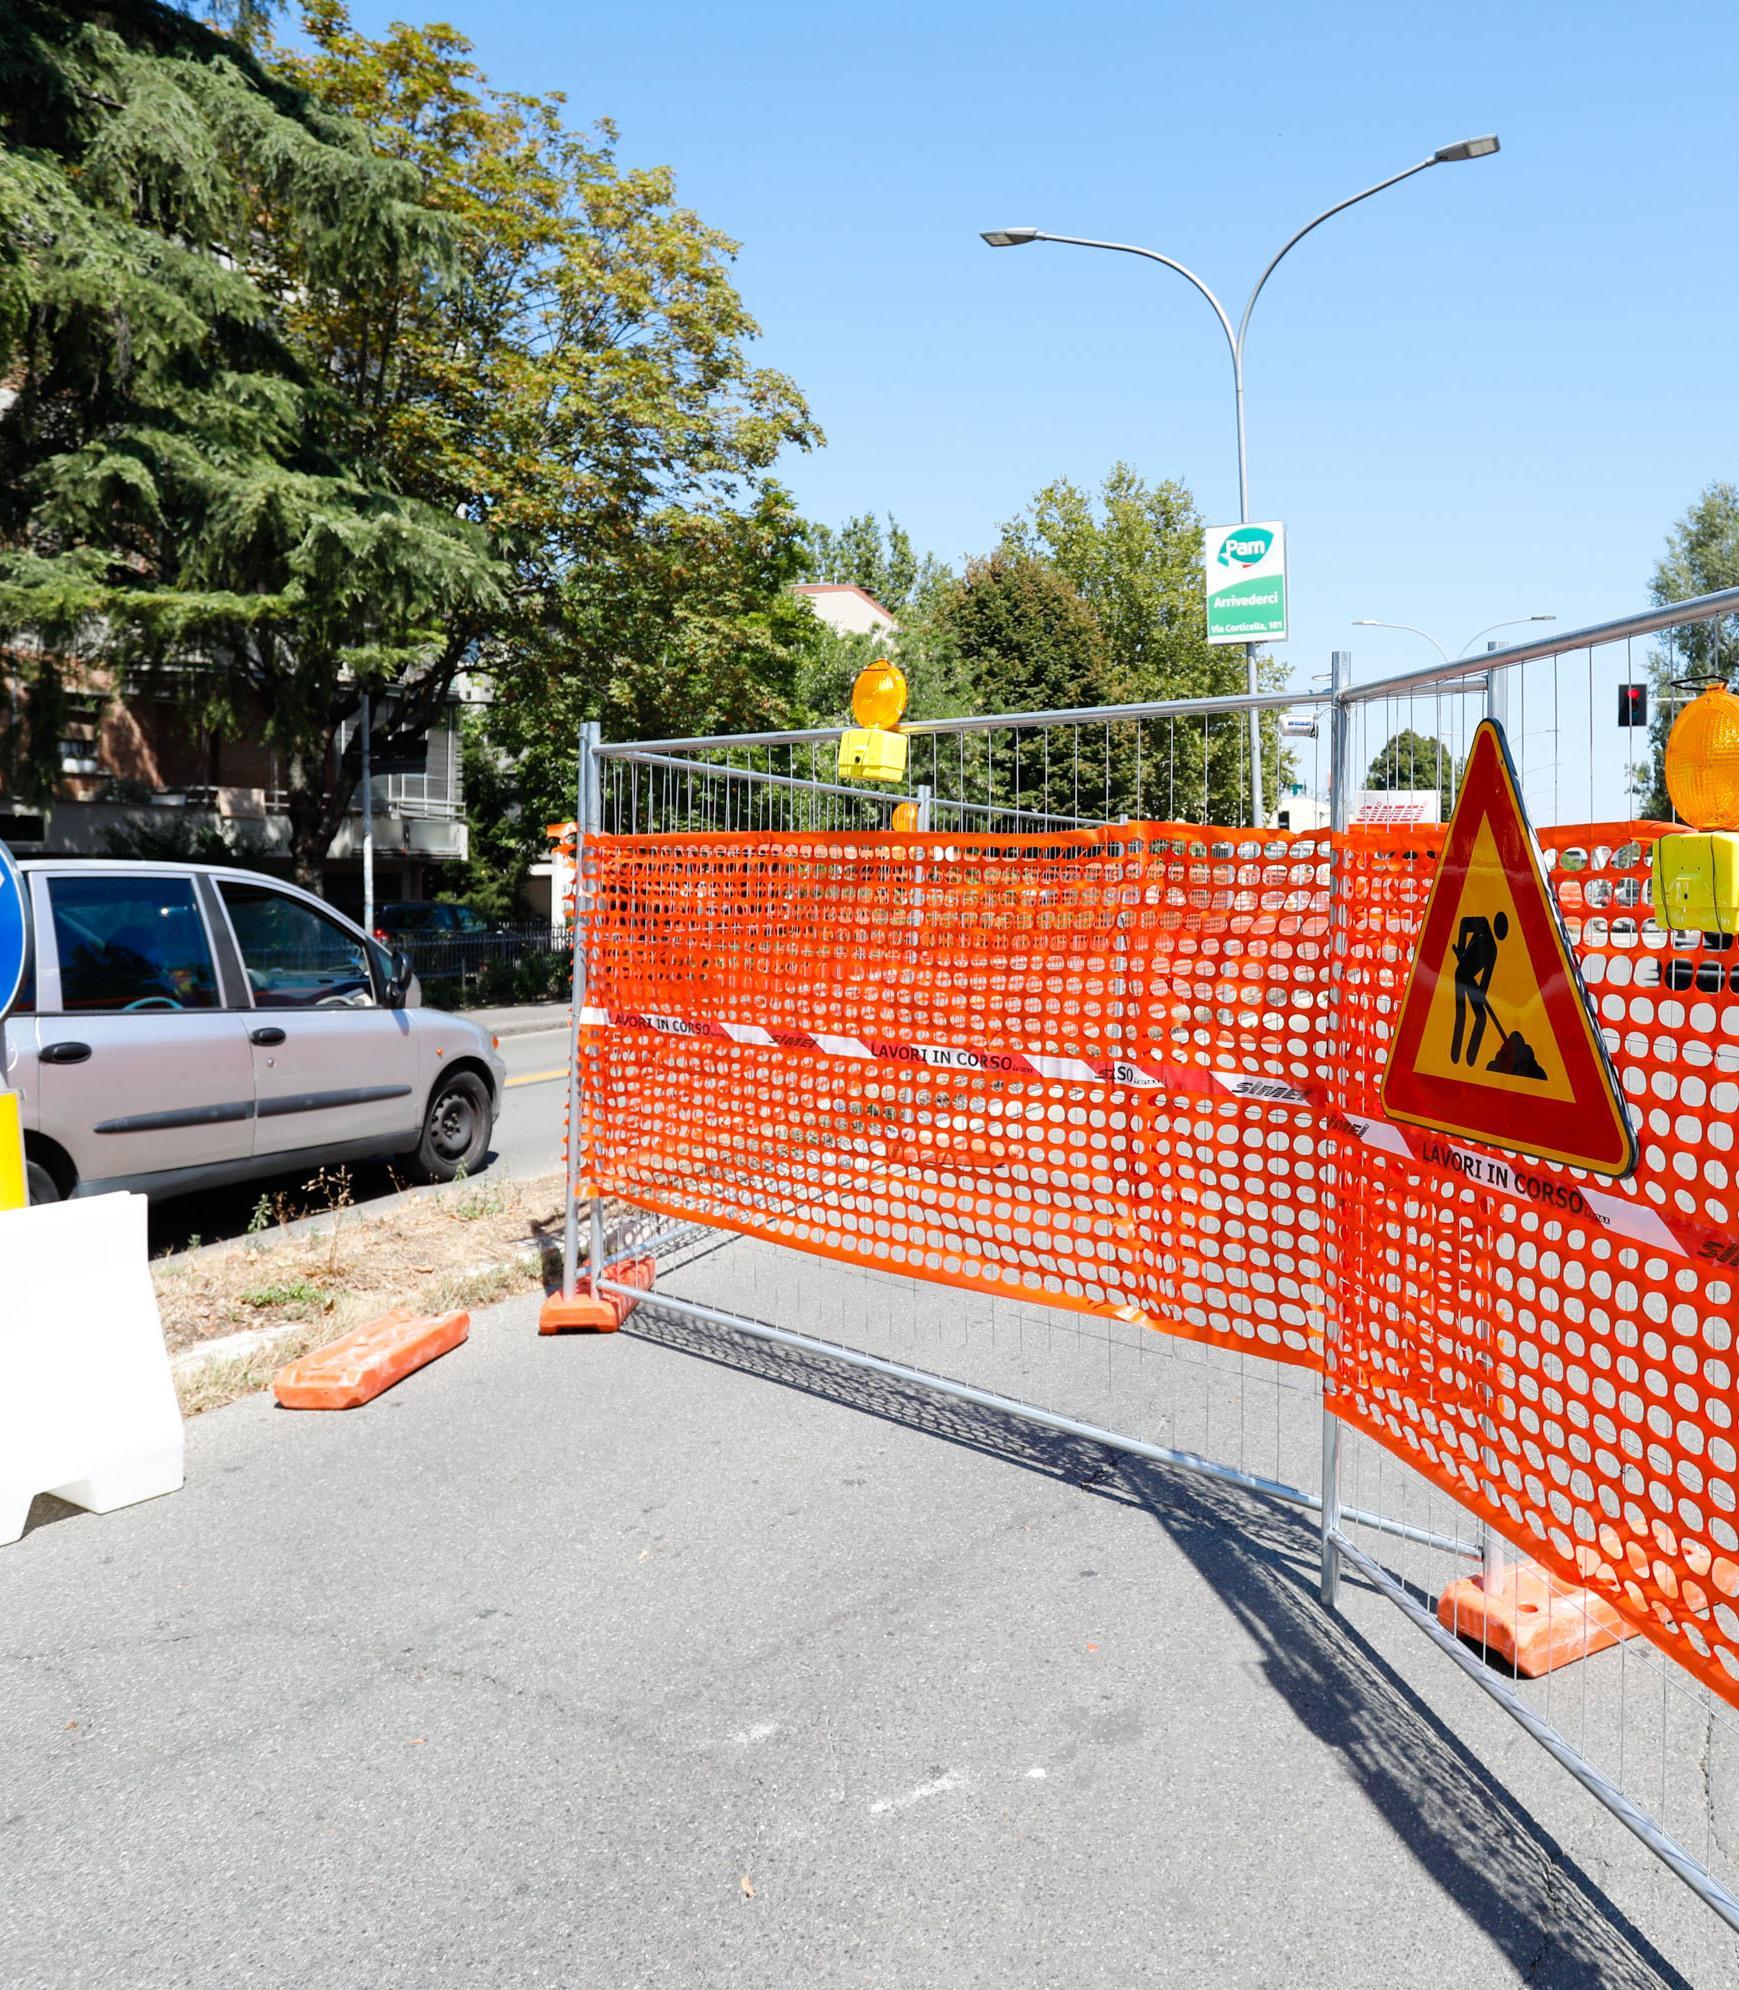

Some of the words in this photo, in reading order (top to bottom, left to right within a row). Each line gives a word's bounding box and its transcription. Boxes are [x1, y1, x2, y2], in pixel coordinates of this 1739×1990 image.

[1226, 540, 1265, 558] Pam
[1214, 593, 1278, 608] Arrivederci
[1211, 625, 1225, 633] Via
[656, 1018, 669, 1030] IN
[672, 1020, 710, 1036] CORSO
[871, 1043, 927, 1062] LAVORI
[932, 1048, 951, 1064] IN
[956, 1051, 1013, 1070] CORSO
[1422, 1142, 1482, 1180] LAVORI
[1487, 1164, 1508, 1188] IN
[1514, 1173, 1583, 1214] CORSO
